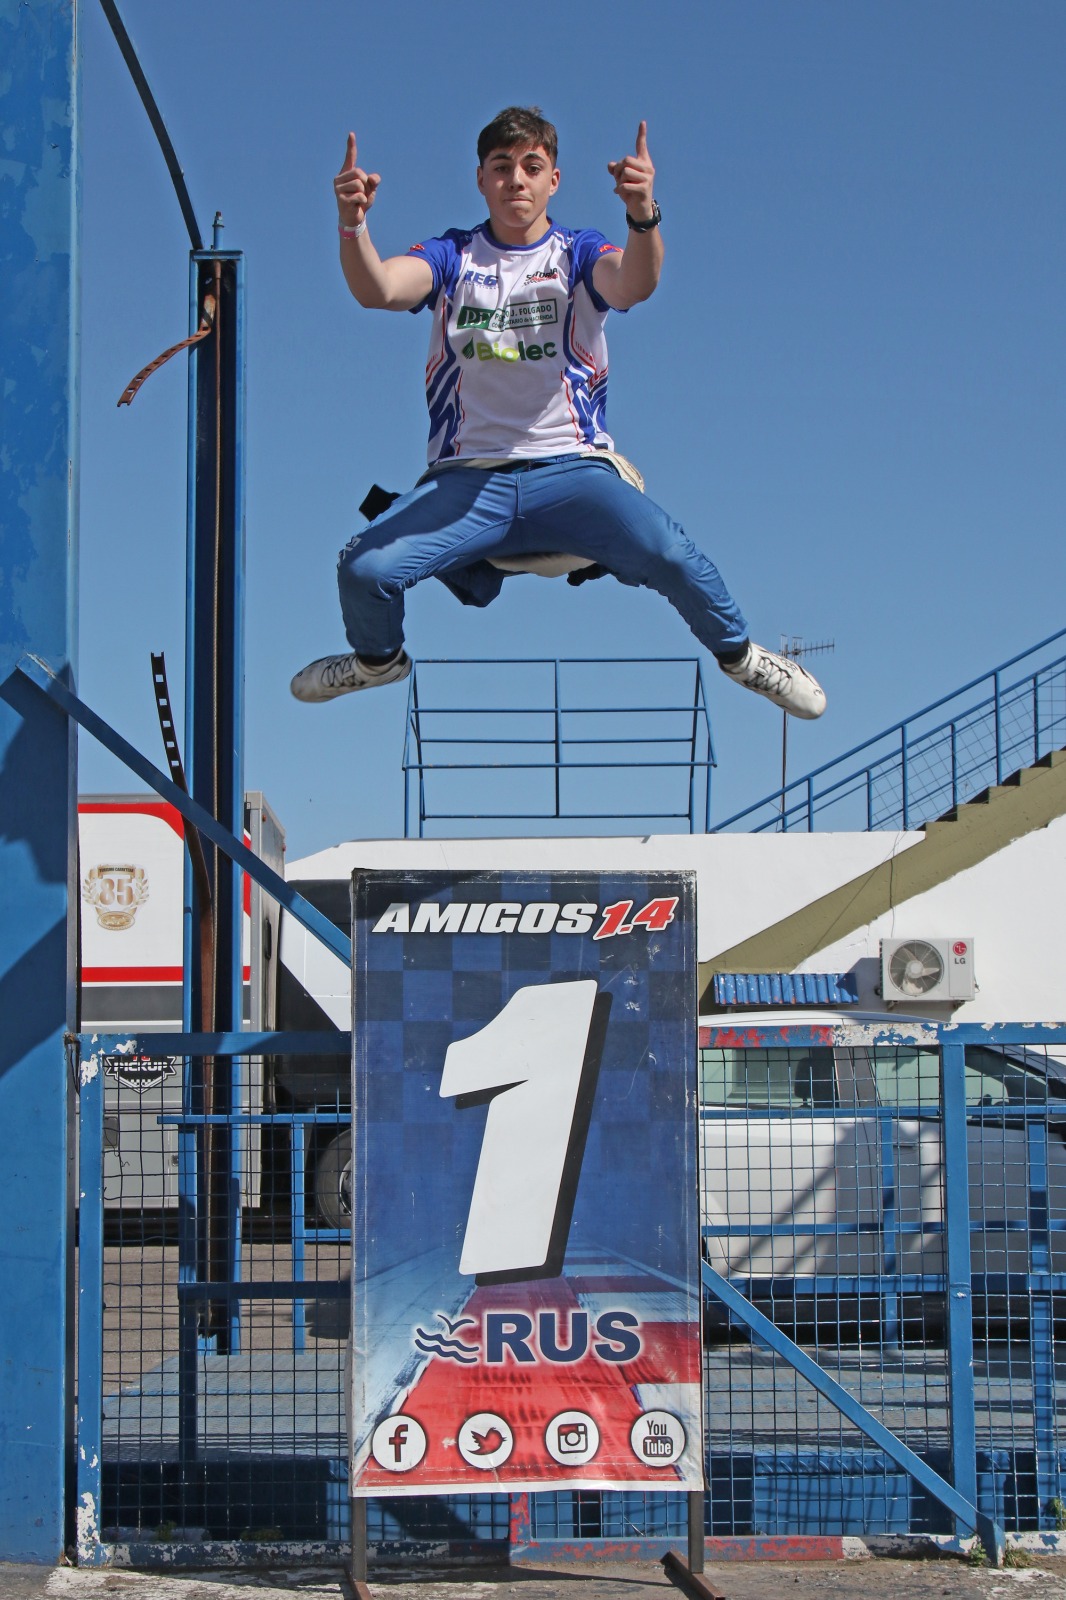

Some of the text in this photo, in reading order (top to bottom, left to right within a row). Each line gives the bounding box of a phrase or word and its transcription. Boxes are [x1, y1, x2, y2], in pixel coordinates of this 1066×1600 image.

[519, 304, 552, 315] FOLGADO
[476, 341, 557, 362] Biolec
[100, 879, 133, 905] 85
[372, 897, 679, 940] AMIGOS 1.4
[954, 957, 966, 965] LG
[114, 1061, 168, 1072] PICKUP
[439, 979, 602, 1278] 1
[486, 1311, 641, 1363] RUS
[646, 1420, 667, 1436] You
[644, 1439, 672, 1455] Tube
